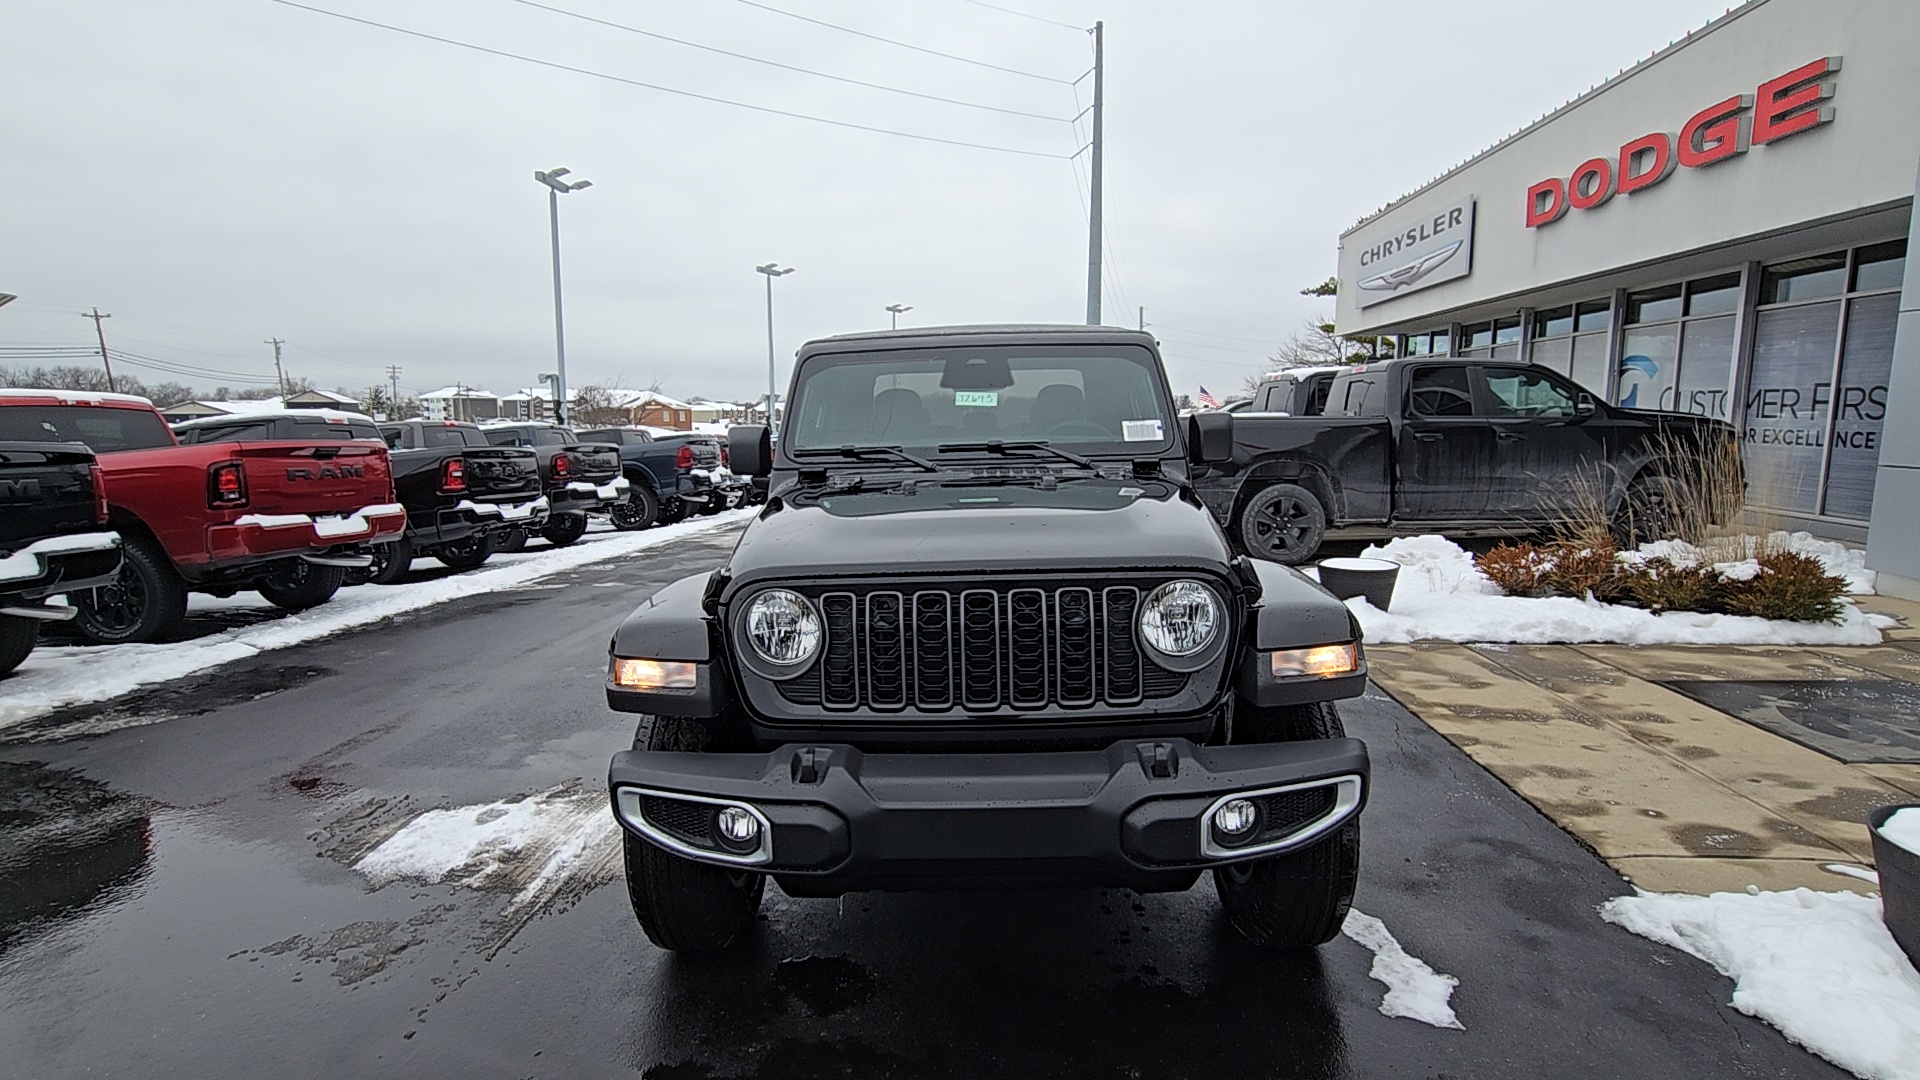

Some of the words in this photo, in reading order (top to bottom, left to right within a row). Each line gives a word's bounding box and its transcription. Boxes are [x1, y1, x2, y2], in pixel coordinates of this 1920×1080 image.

[1526, 56, 1839, 228] DODGE
[1360, 206, 1463, 267] CHRYSLER
[1761, 429, 1877, 450] EXCELLNCE
[286, 465, 363, 481] RAM
